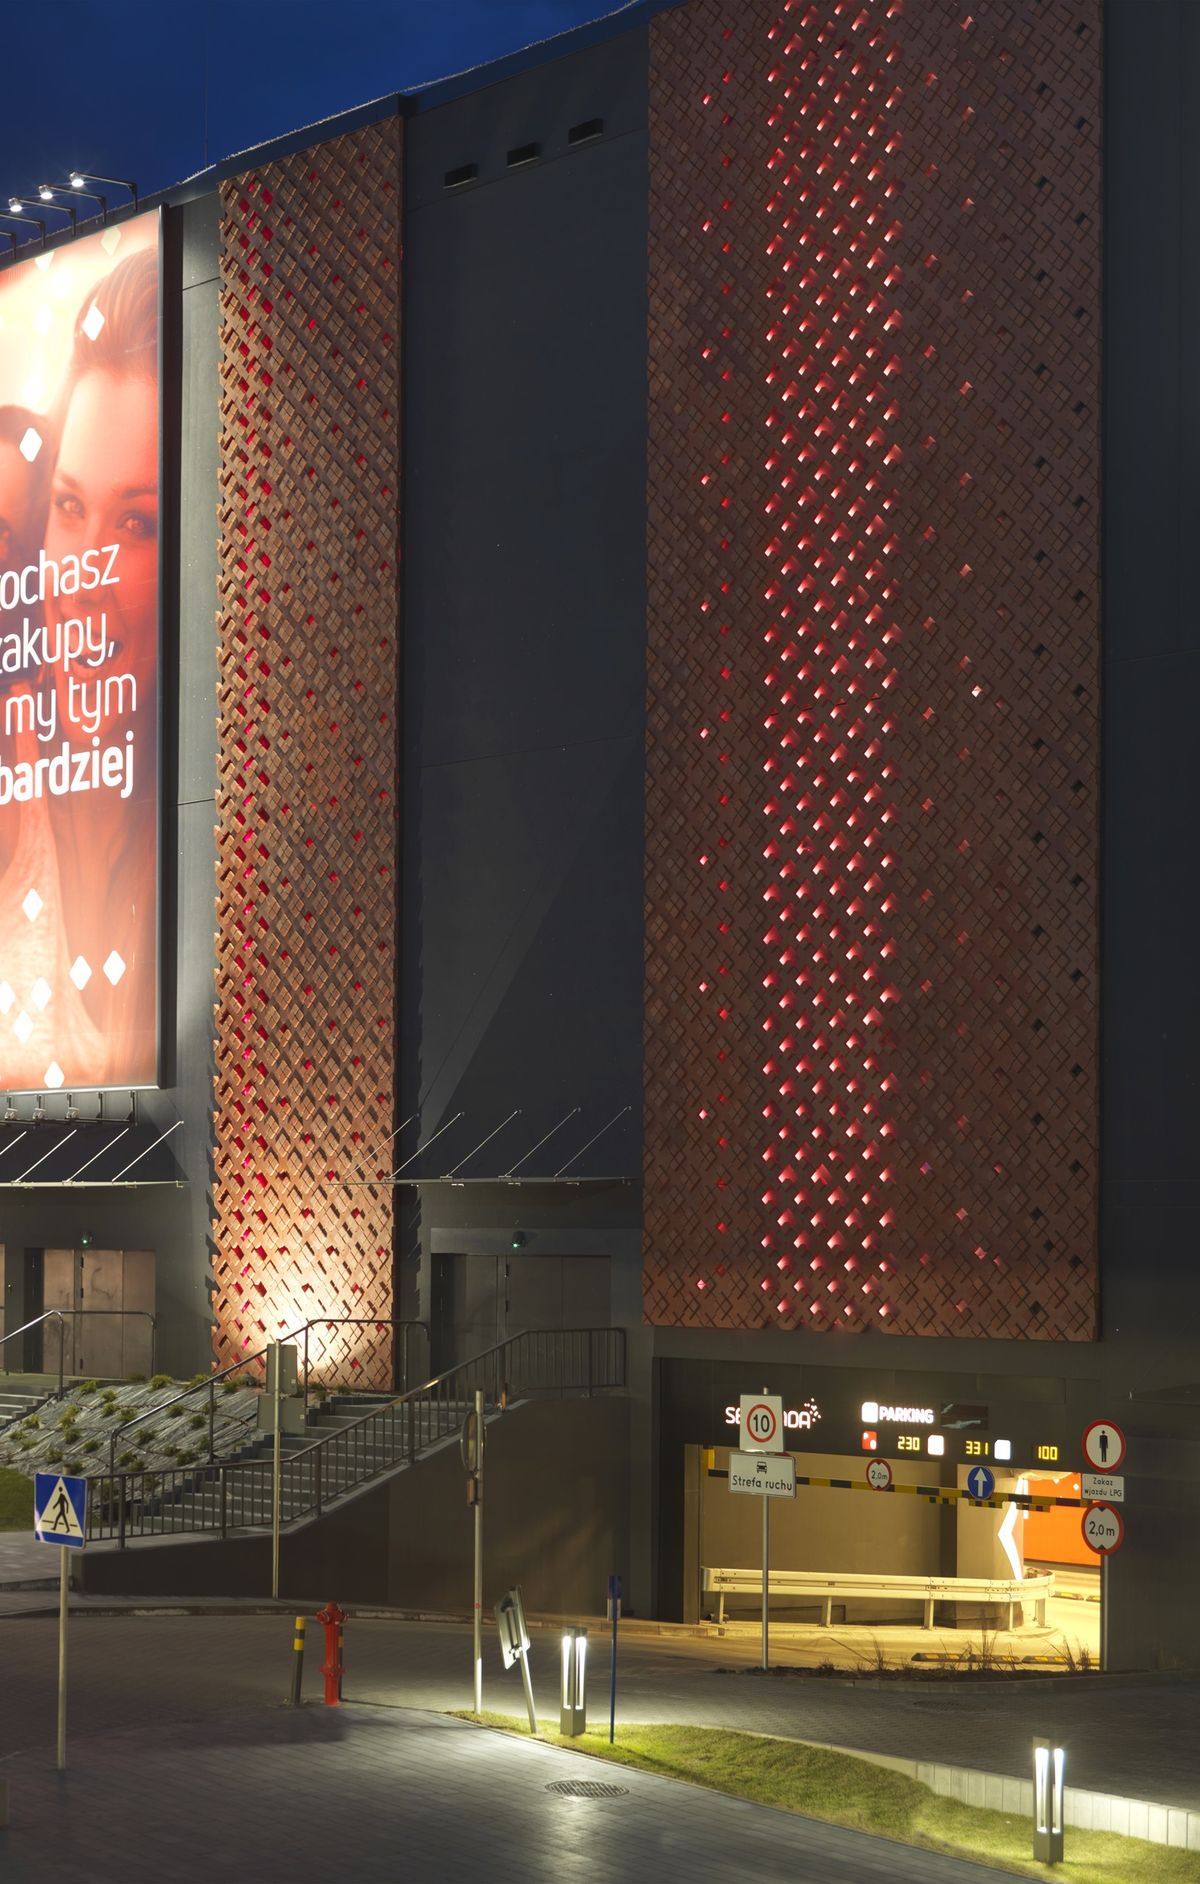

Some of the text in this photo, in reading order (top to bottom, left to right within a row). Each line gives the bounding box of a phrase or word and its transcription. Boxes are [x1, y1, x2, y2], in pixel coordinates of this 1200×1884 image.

[5, 688, 57, 742] my
[68, 673, 136, 733] tym
[879, 1406, 934, 1424] PARKING
[753, 1414, 770, 1433] 10
[897, 1435, 920, 1451] 230
[965, 1440, 989, 1455] 331
[1038, 1446, 1058, 1461] 100
[732, 1475, 792, 1491] Strefa ruchu
[1093, 1477, 1113, 1486] Zakaz
[1085, 1487, 1122, 1497] wjazdu LPG
